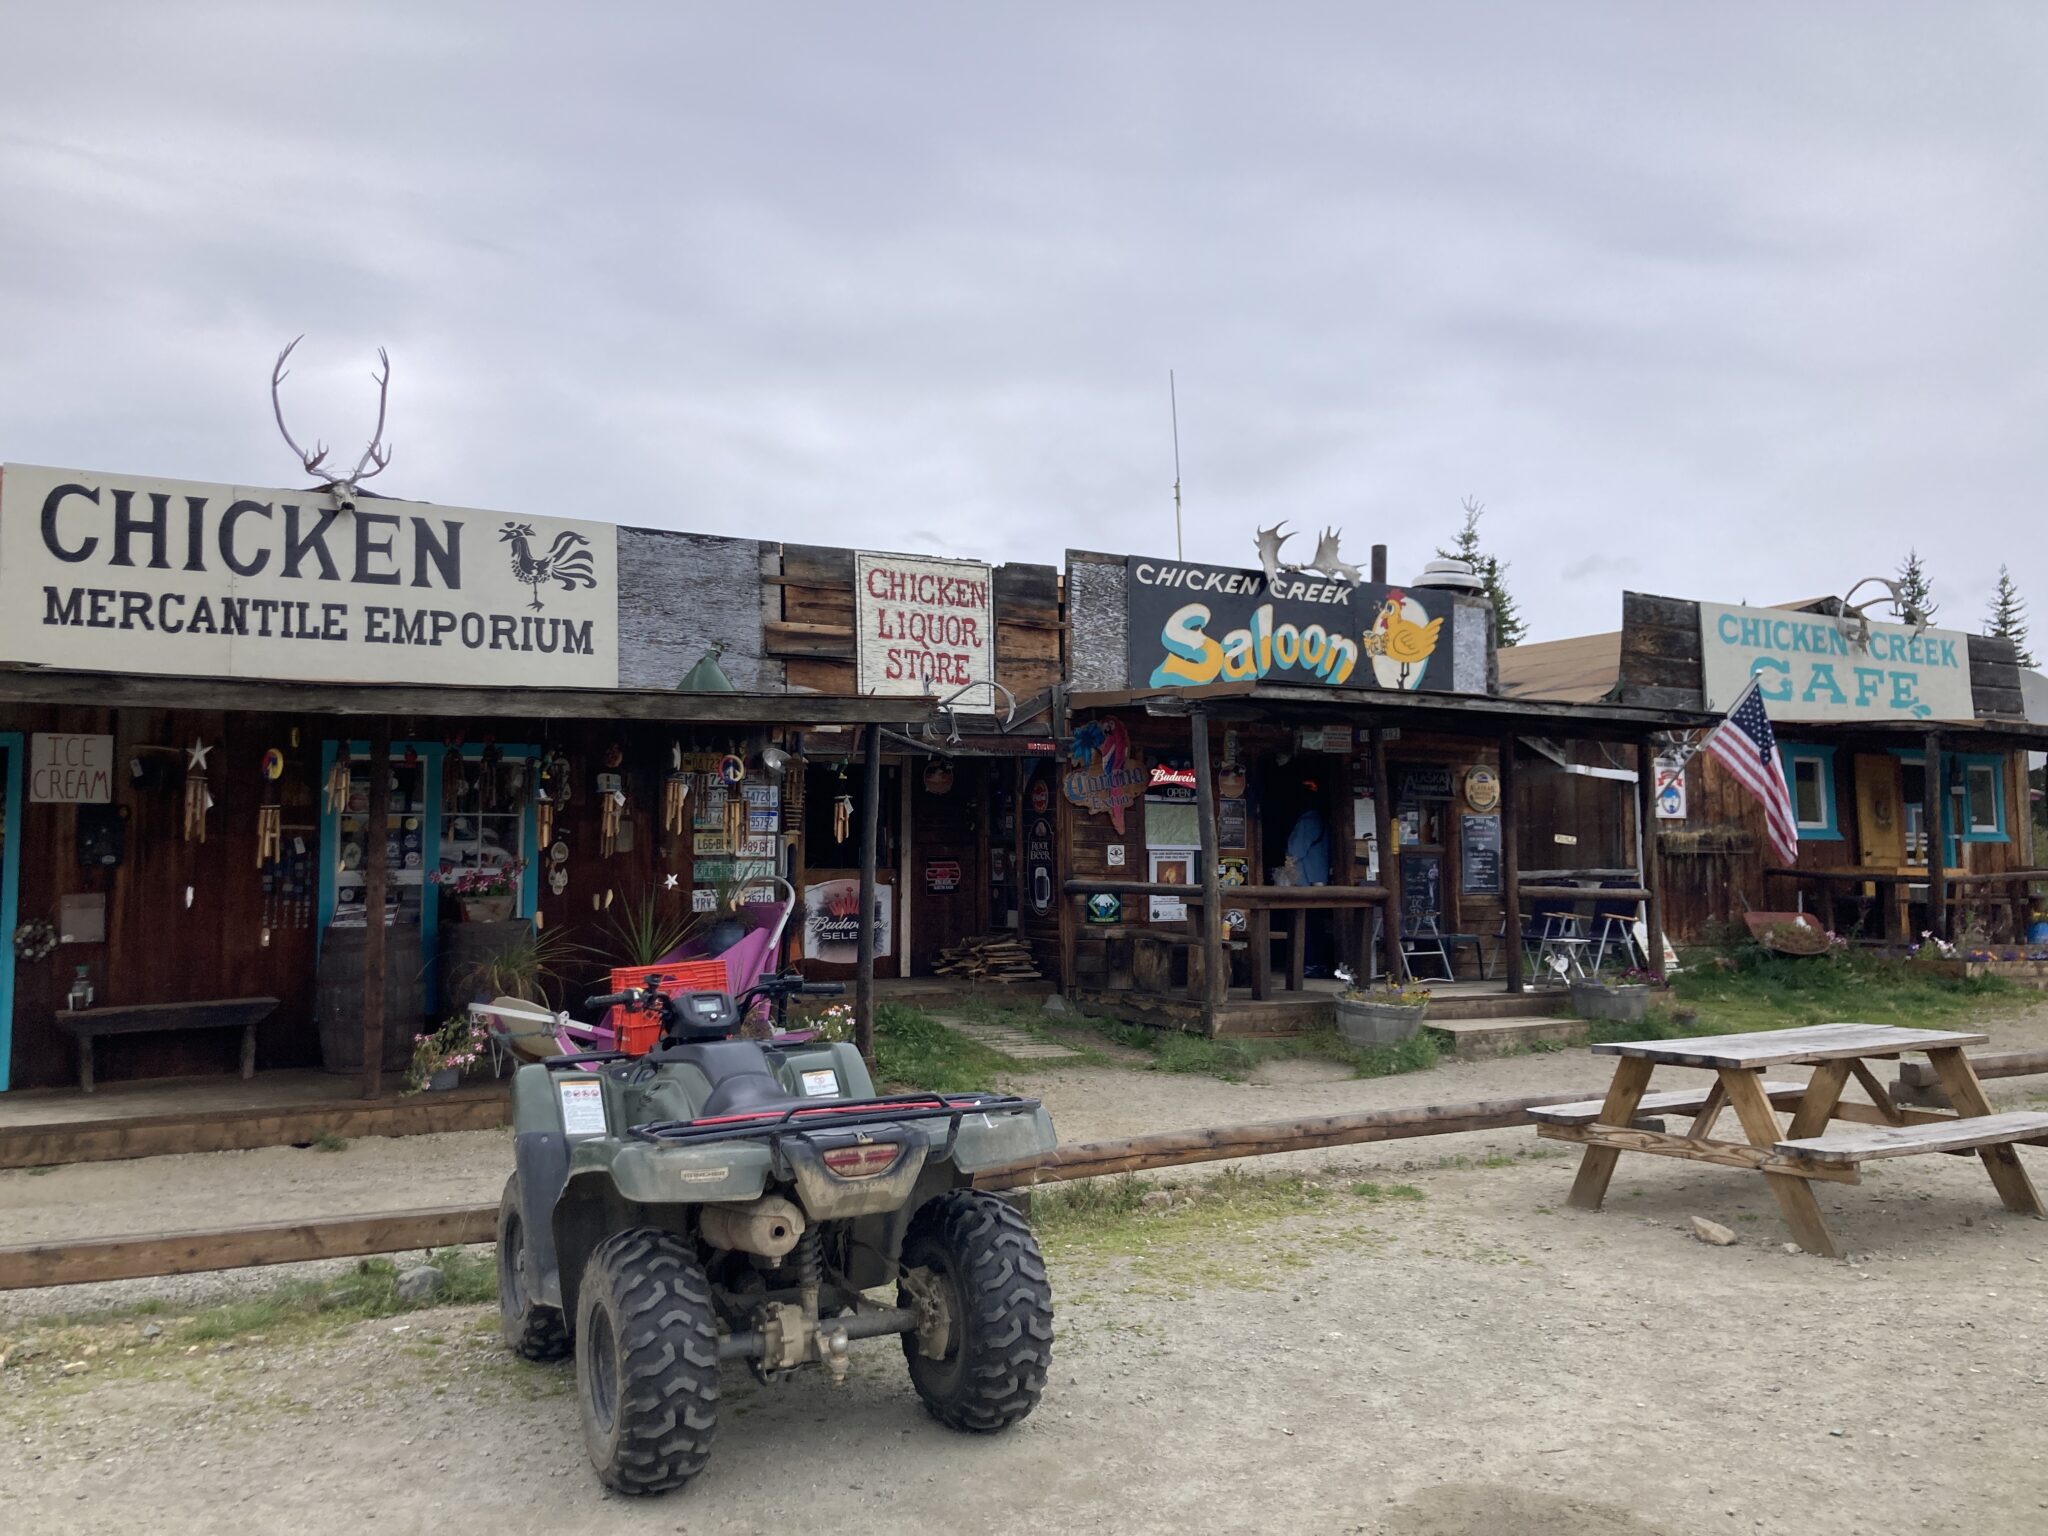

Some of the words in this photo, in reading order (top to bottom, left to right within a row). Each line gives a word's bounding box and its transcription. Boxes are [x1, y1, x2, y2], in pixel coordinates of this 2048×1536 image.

[40, 483, 464, 590] CHICKEN
[867, 568, 987, 609] CHICKEN
[1136, 563, 1261, 596] CHICKEN
[1270, 579, 1353, 606] CREEK
[43, 586, 348, 641] MERCANTILE
[364, 606, 595, 655] EMPORIUM
[878, 608, 982, 649] LIQUOR
[1718, 613, 1849, 656] CHICKEN
[1871, 629, 1959, 669] CREEK
[1149, 603, 1358, 688] Saloon
[886, 648, 971, 685] STORE
[48, 736, 97, 767] ICE
[33, 769, 110, 800] CREAM
[1150, 768, 1197, 783] Budweis
[1166, 788, 1191, 798] OPEN
